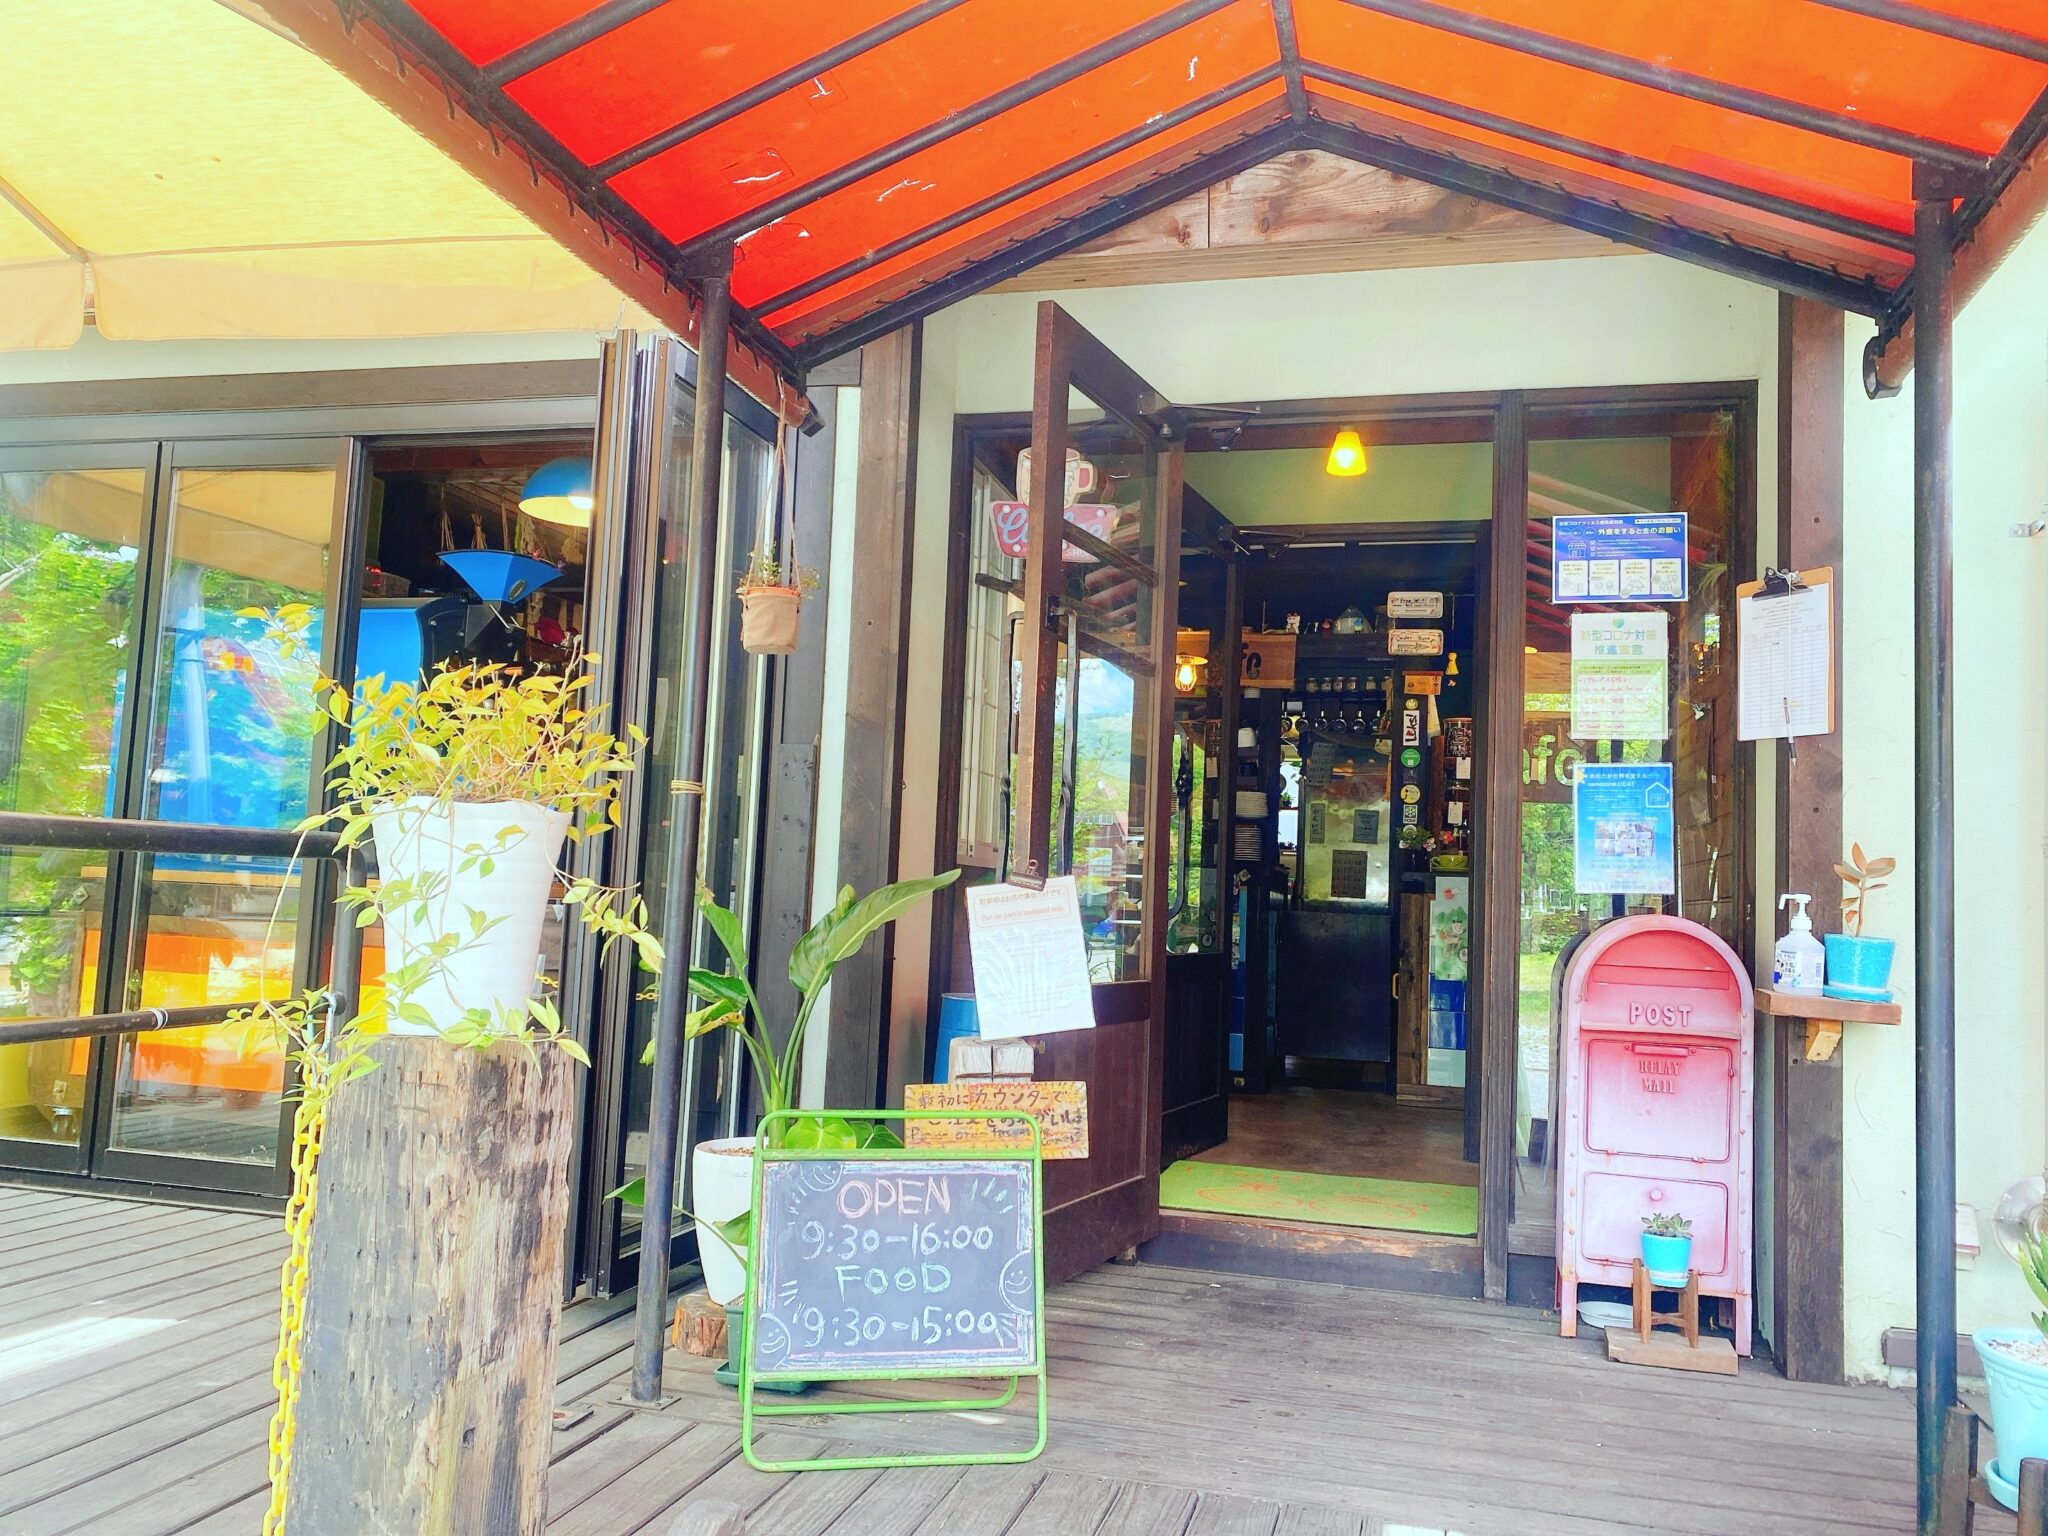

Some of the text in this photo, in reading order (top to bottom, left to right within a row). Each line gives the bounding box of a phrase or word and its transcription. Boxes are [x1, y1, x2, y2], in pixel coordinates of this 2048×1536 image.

[1579, 629, 1657, 642] 新型コロナ対策
[1629, 1002, 1693, 1028] POST
[1639, 1060, 1682, 1075] RELAY
[1643, 1079, 1676, 1094] MAIL
[919, 1088, 1068, 1109] 最初にカウンターで
[837, 1175, 951, 1218] OPEN
